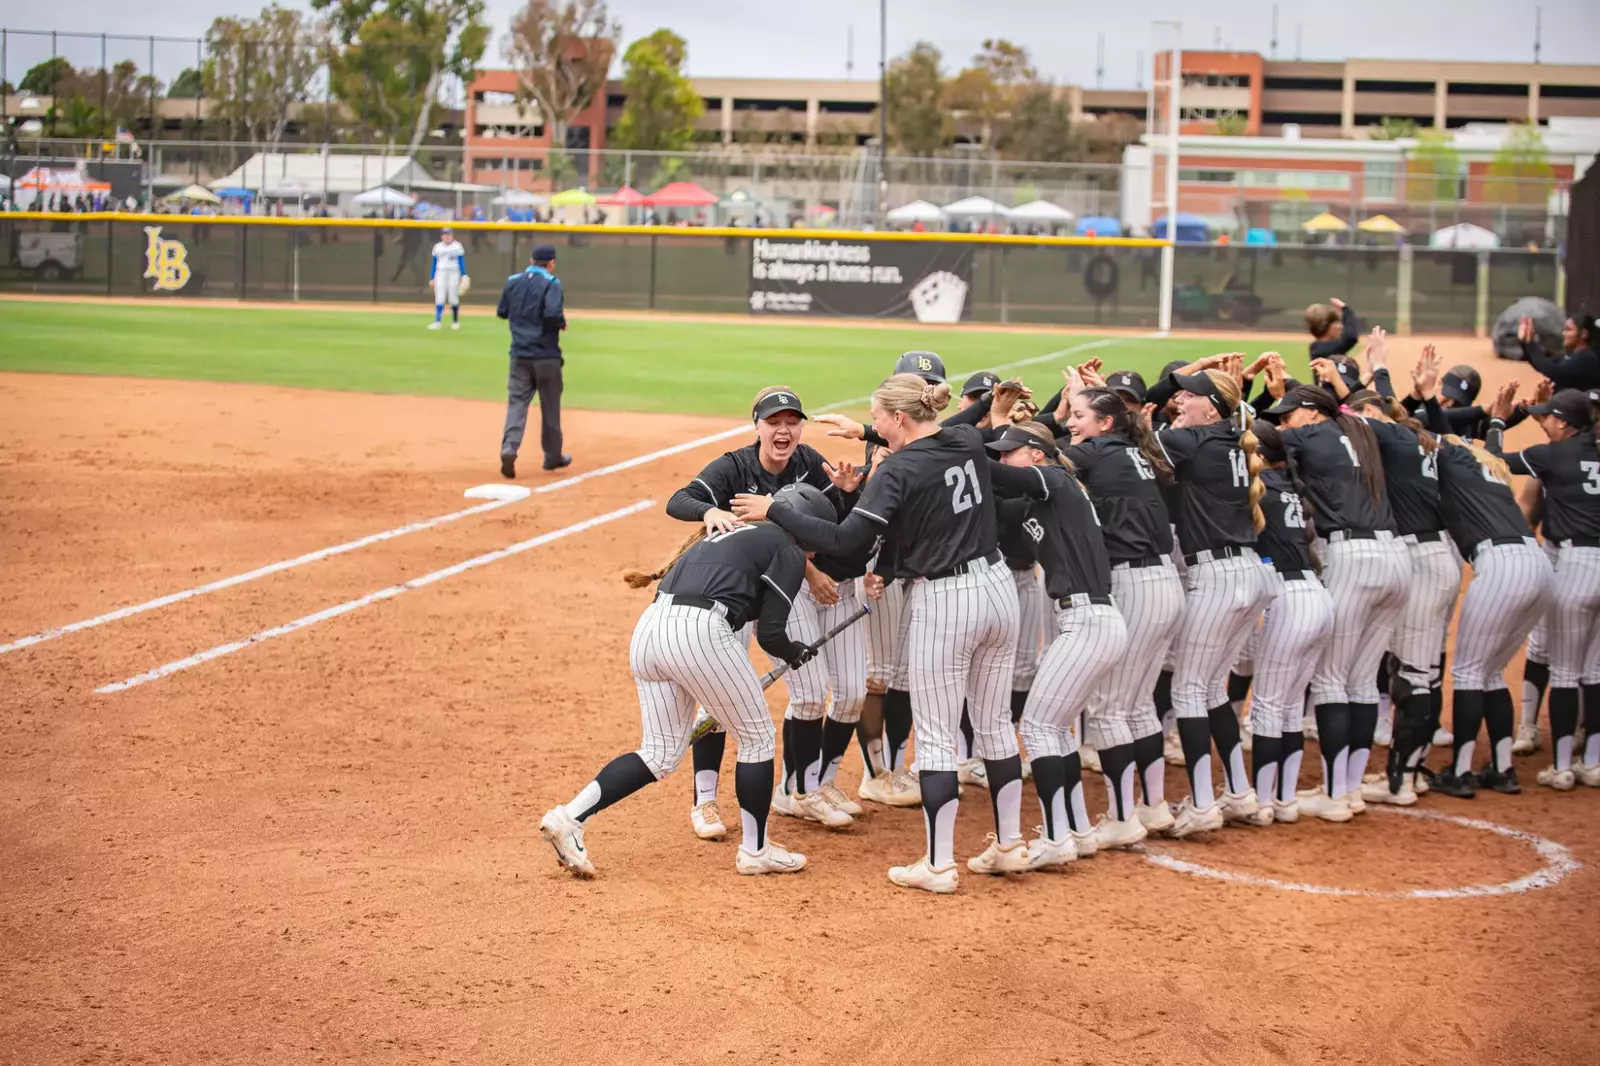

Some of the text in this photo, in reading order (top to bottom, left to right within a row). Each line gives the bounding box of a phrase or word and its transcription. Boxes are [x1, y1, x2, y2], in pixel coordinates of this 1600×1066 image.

[143, 226, 191, 291] LB
[918, 355, 932, 371] LB
[944, 459, 982, 515] 21
[1229, 449, 1249, 487] 14
